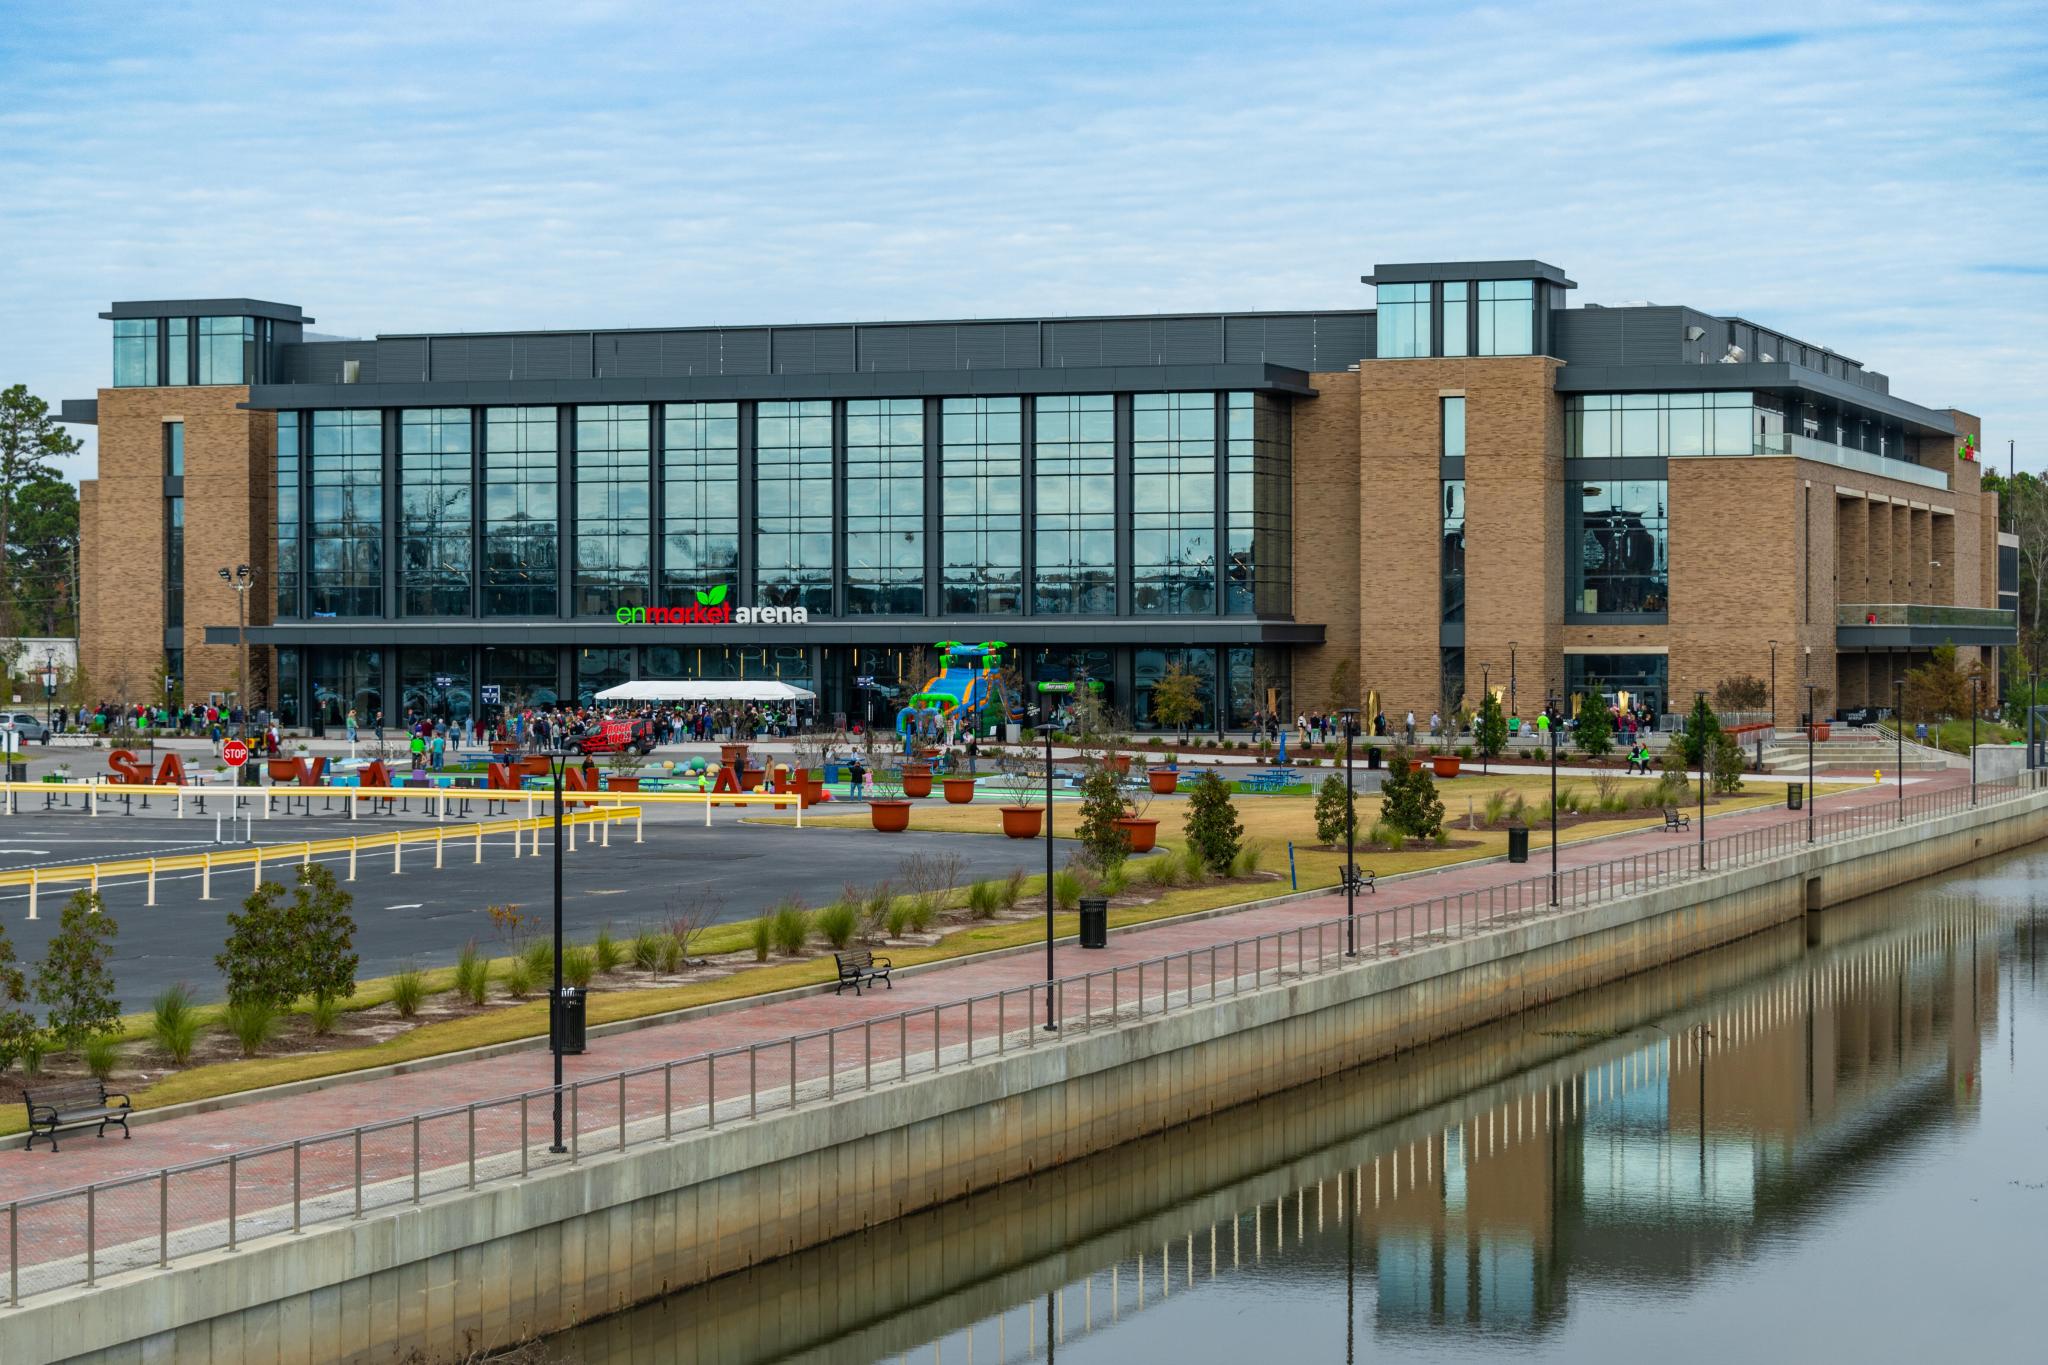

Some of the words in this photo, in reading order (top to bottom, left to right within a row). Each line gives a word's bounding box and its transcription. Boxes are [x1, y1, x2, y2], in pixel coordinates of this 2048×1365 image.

[616, 601, 732, 624] enmarket
[735, 606, 808, 624] arena
[607, 722, 633, 735] ROCK
[225, 749, 246, 759] STOP
